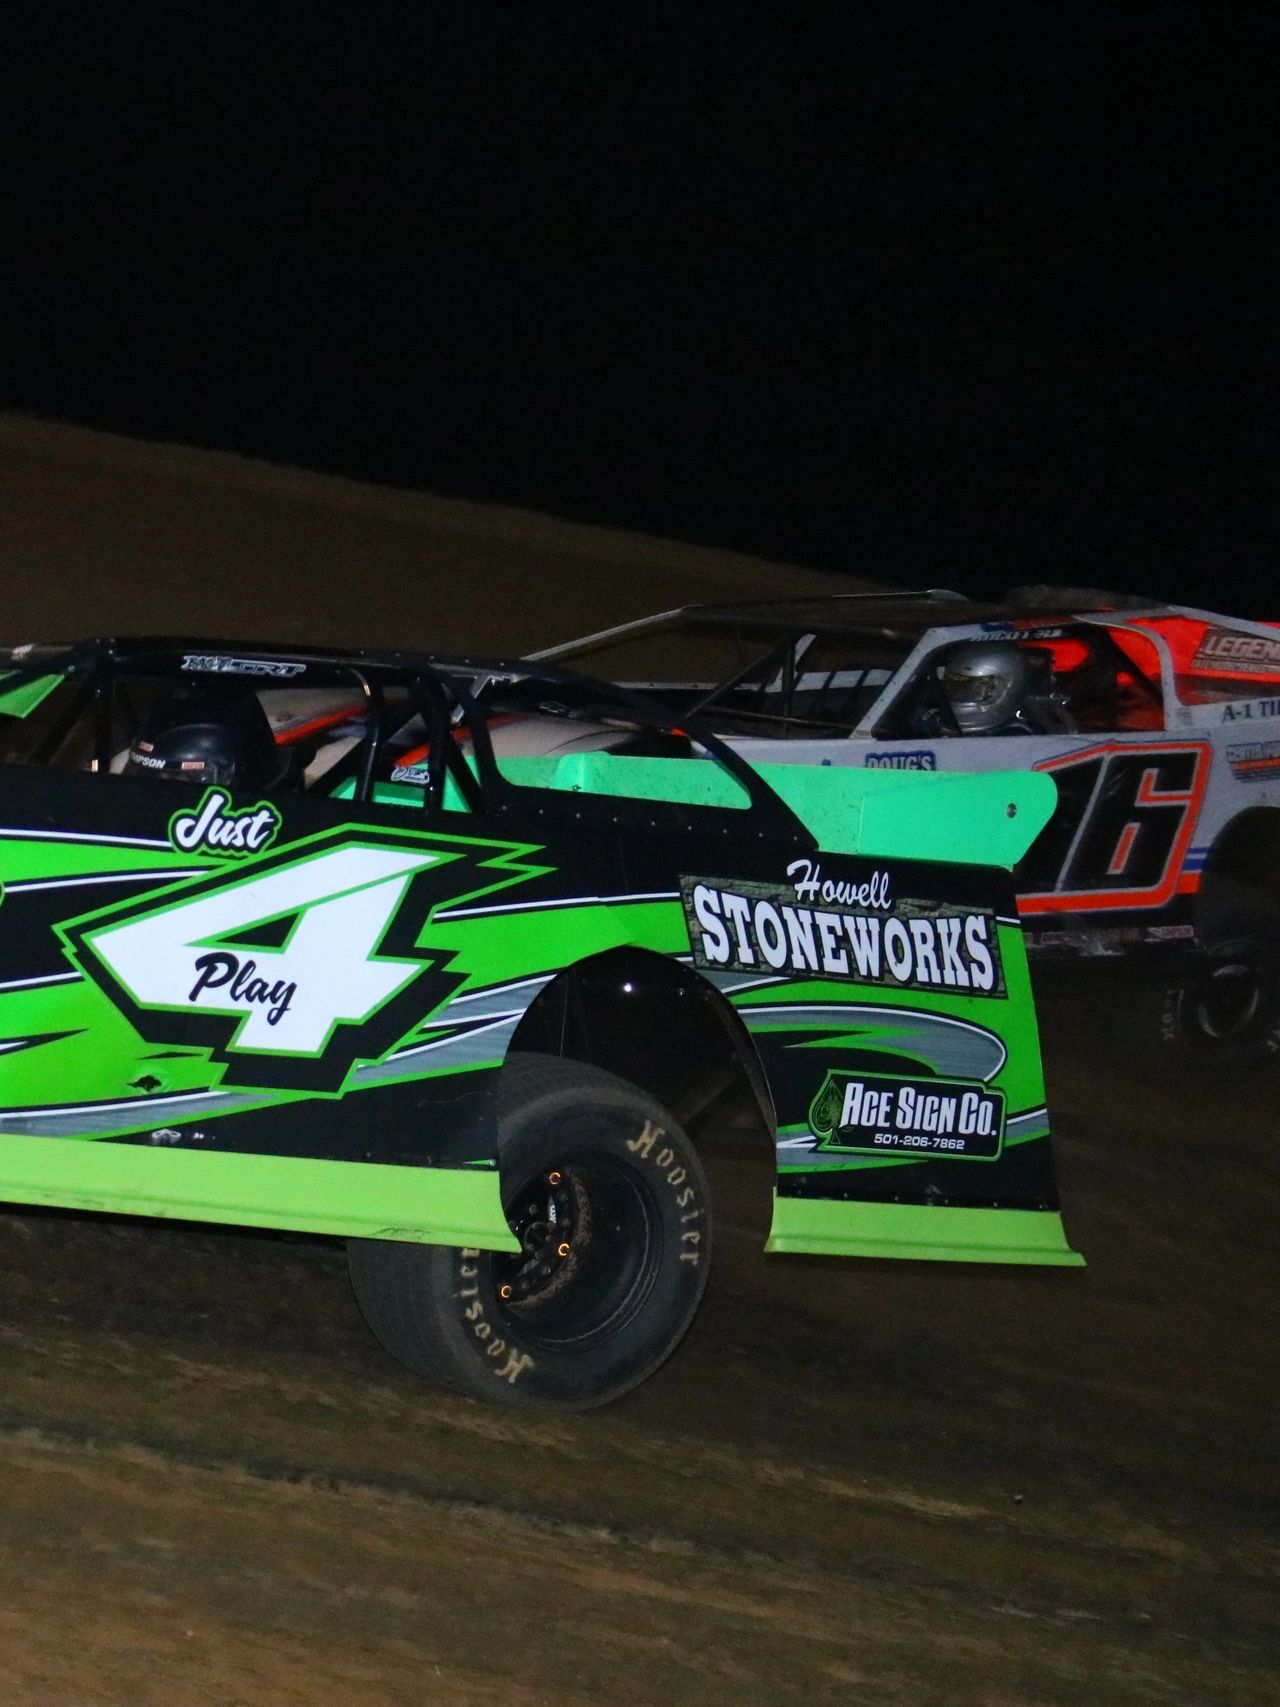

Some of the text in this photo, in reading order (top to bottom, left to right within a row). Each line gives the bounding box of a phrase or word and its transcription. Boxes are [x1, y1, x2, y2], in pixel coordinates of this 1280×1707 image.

[1221, 699, 1280, 723] A-1 TI
[173, 794, 271, 851] Just
[787, 859, 892, 909] Howell
[91, 842, 440, 1056] 4
[694, 884, 996, 991] STONEWORKS
[188, 952, 298, 1026] Play
[874, 1133, 966, 1151] 501-206-7862
[626, 1121, 704, 1267] Hoosier
